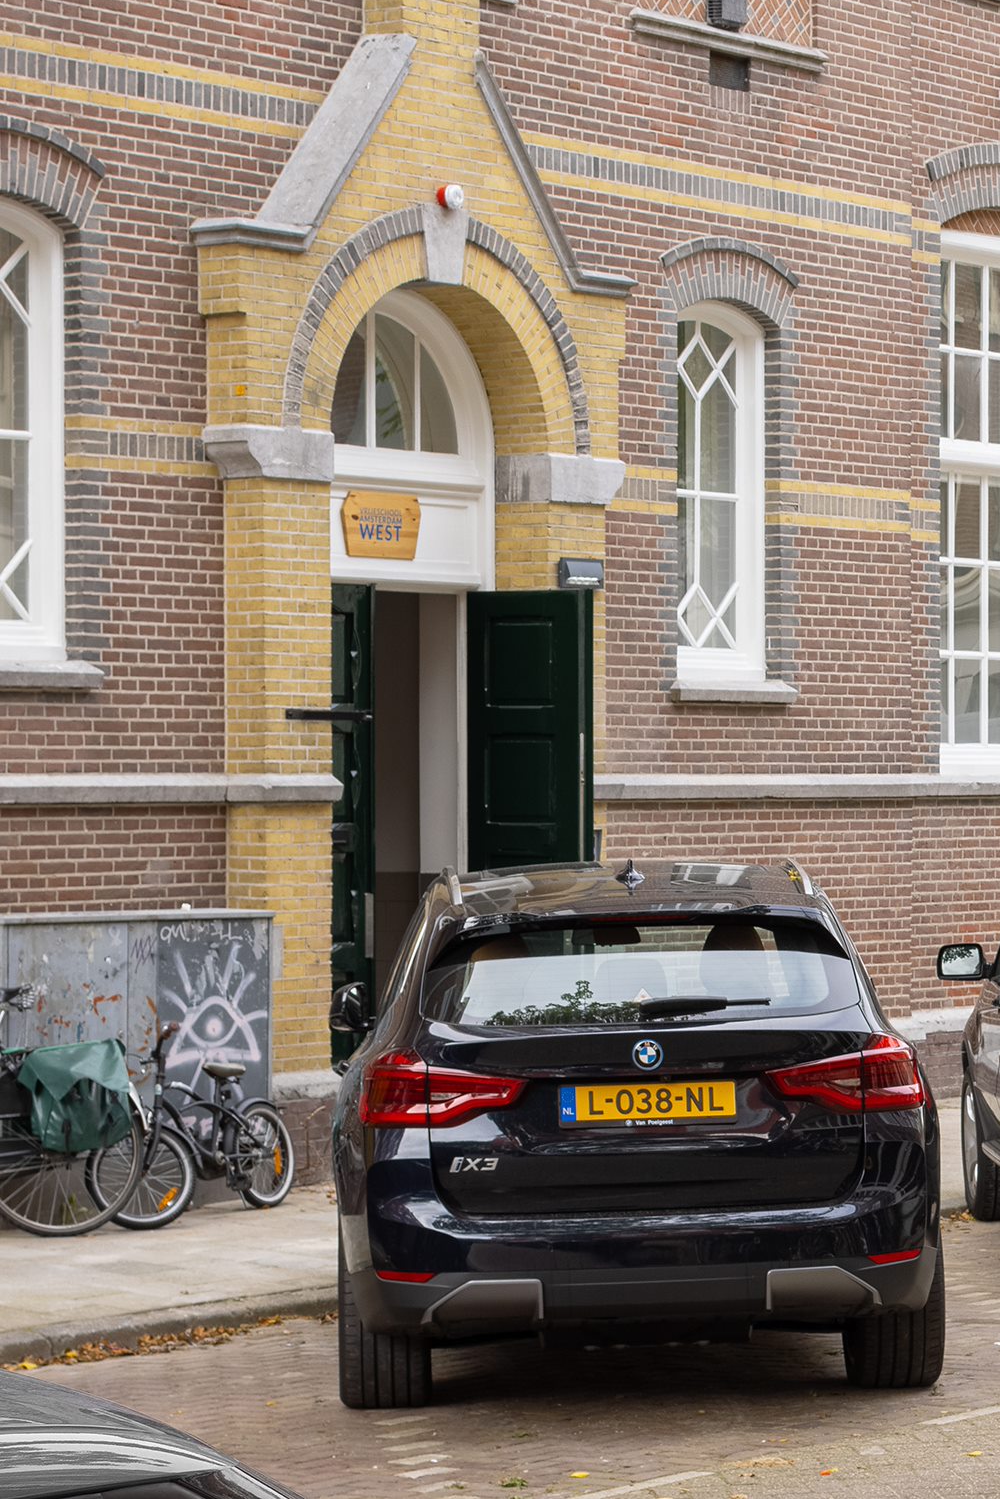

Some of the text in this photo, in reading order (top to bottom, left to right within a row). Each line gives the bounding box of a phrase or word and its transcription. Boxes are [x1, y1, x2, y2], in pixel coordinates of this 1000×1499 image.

[360, 515, 402, 525] AMSTERDAM
[359, 523, 402, 542] WEST
[588, 1087, 724, 1115] L-038-NL
[562, 1107, 574, 1116] NL
[647, 1118, 674, 1126] Poelgeest
[449, 1156, 499, 1173] iX3
